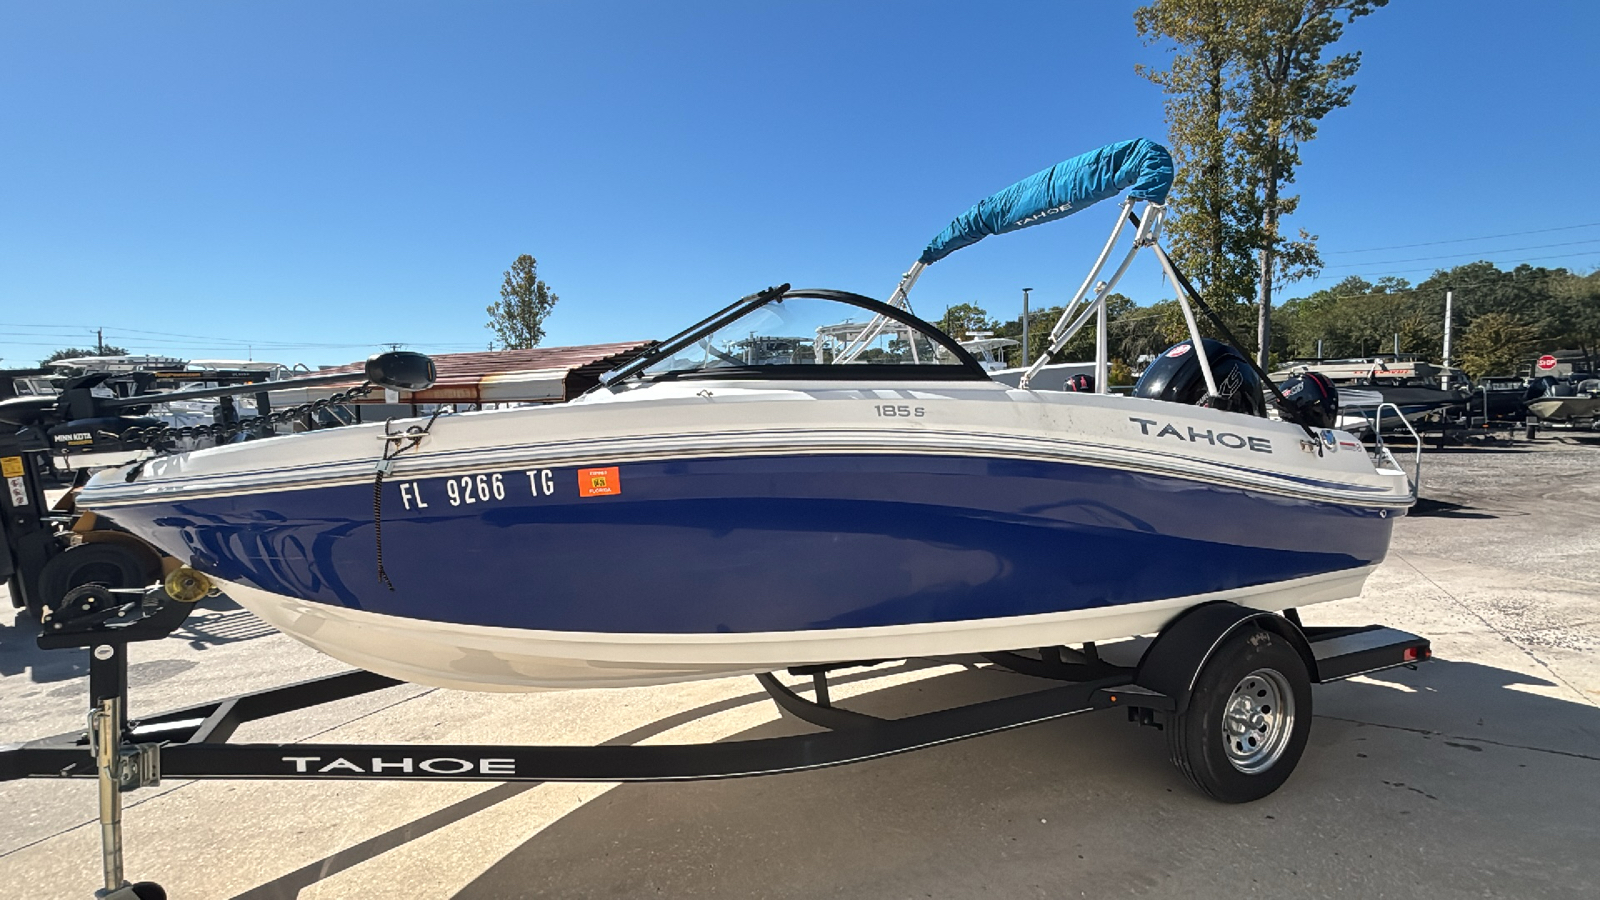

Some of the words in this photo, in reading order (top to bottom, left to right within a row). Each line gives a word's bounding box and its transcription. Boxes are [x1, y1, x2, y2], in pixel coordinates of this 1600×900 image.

[1014, 201, 1073, 226] TAHOE
[874, 405, 911, 417] 185
[54, 433, 73, 442] MINN
[73, 432, 92, 441] KOTA
[1129, 416, 1273, 454] TAHOE
[399, 482, 428, 510] FL
[447, 473, 506, 507] 9266
[526, 469, 554, 497] TG
[281, 756, 516, 774] TAHOE
